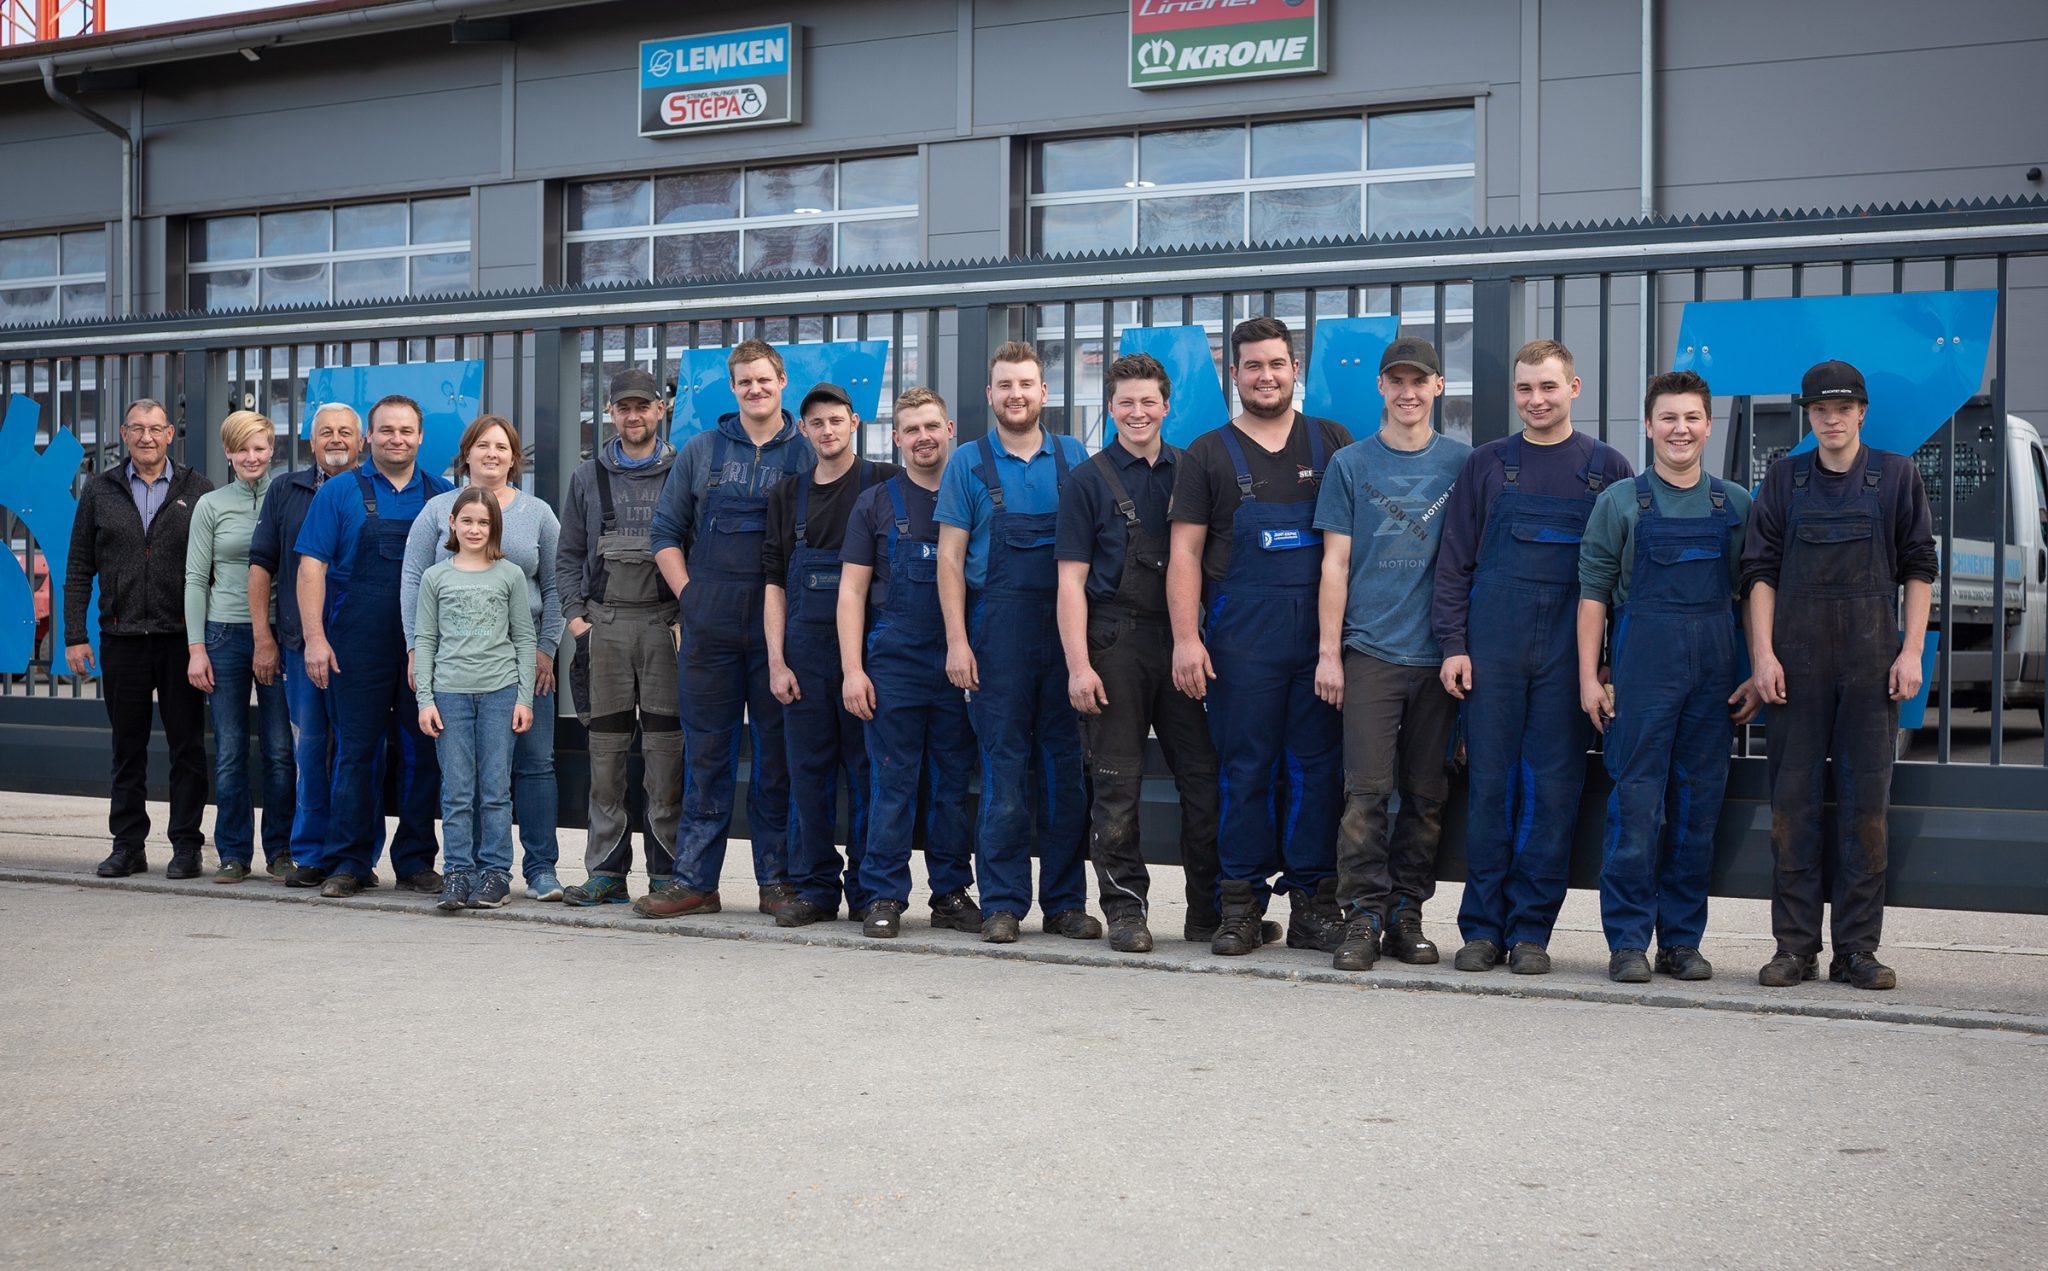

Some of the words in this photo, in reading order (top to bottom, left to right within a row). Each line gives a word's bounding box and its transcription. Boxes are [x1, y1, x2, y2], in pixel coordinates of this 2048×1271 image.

[675, 37, 784, 75] LEMKEN
[1177, 36, 1308, 71] KRONE
[669, 94, 741, 123] STEPA
[626, 506, 652, 521] LTD
[1361, 482, 1406, 521] MOTION
[1406, 519, 1428, 541] TEN
[1421, 491, 1449, 522] MOTION
[1378, 559, 1425, 569] MOTION
